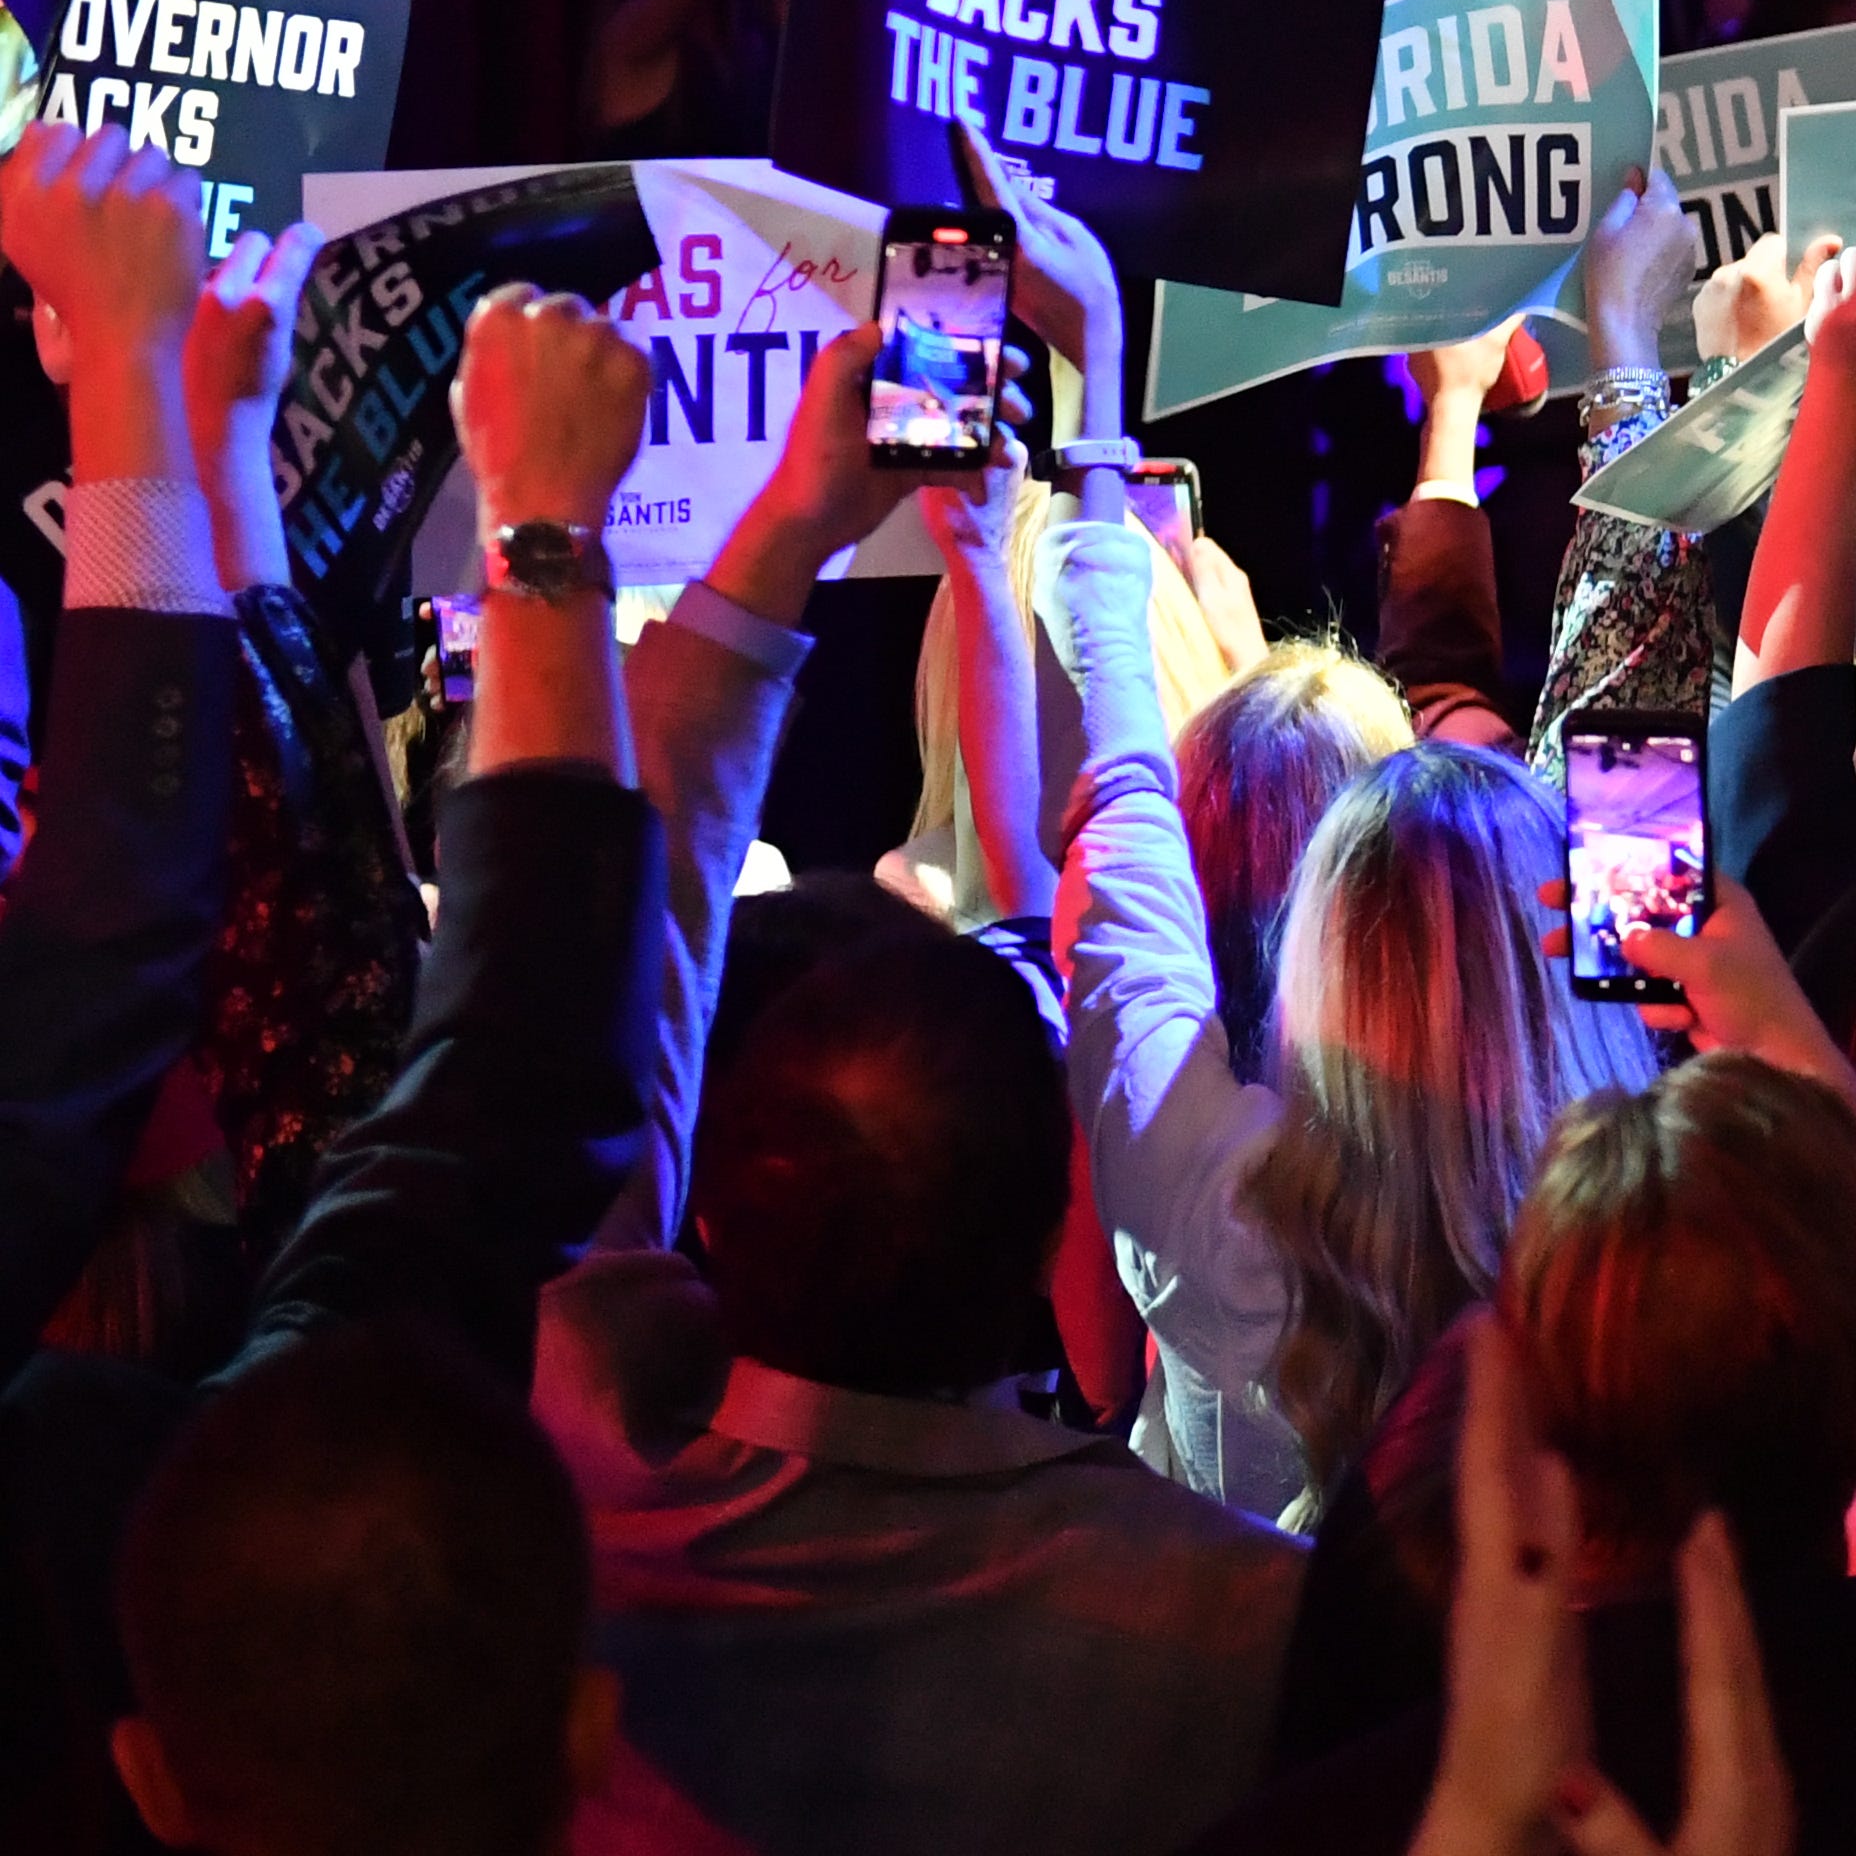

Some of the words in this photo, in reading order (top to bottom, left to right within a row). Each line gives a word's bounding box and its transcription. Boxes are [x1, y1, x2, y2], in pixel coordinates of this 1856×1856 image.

[40, 75, 220, 167] ACKS
[886, 11, 992, 129] THE
[1002, 55, 1212, 171] BLUE
[1365, 0, 1592, 138] RIDA
[1356, 133, 1581, 257] RONG
[736, 241, 858, 354] for
[285, 452, 368, 582] HE
[605, 498, 692, 527] SANTIS
